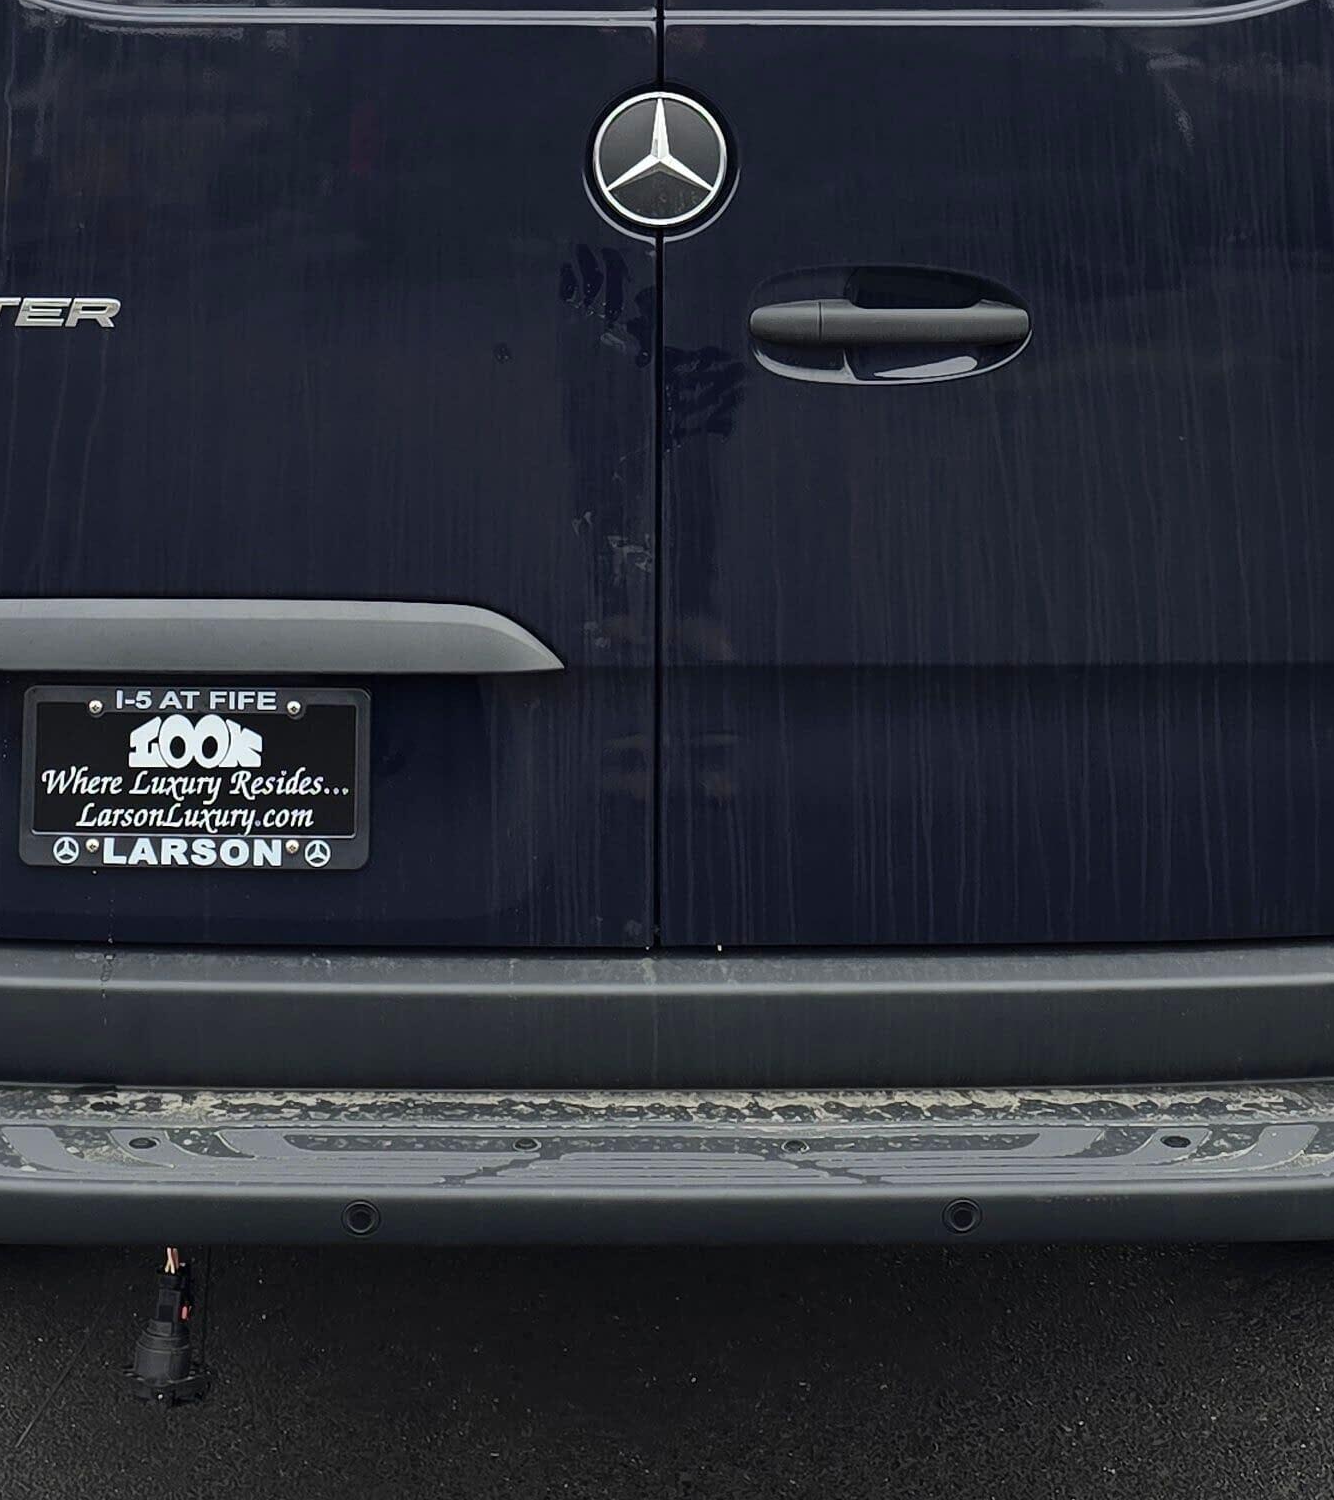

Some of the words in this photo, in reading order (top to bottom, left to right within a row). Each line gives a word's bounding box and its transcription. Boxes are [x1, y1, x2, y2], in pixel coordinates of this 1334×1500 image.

[116, 690, 153, 710] I-5
[158, 690, 199, 710] AT
[209, 691, 277, 711] FIFE
[41, 766, 124, 796] Where
[129, 770, 222, 802] Luxury
[75, 803, 315, 836] LarsonLuxury.com
[102, 838, 284, 866] LARSON
